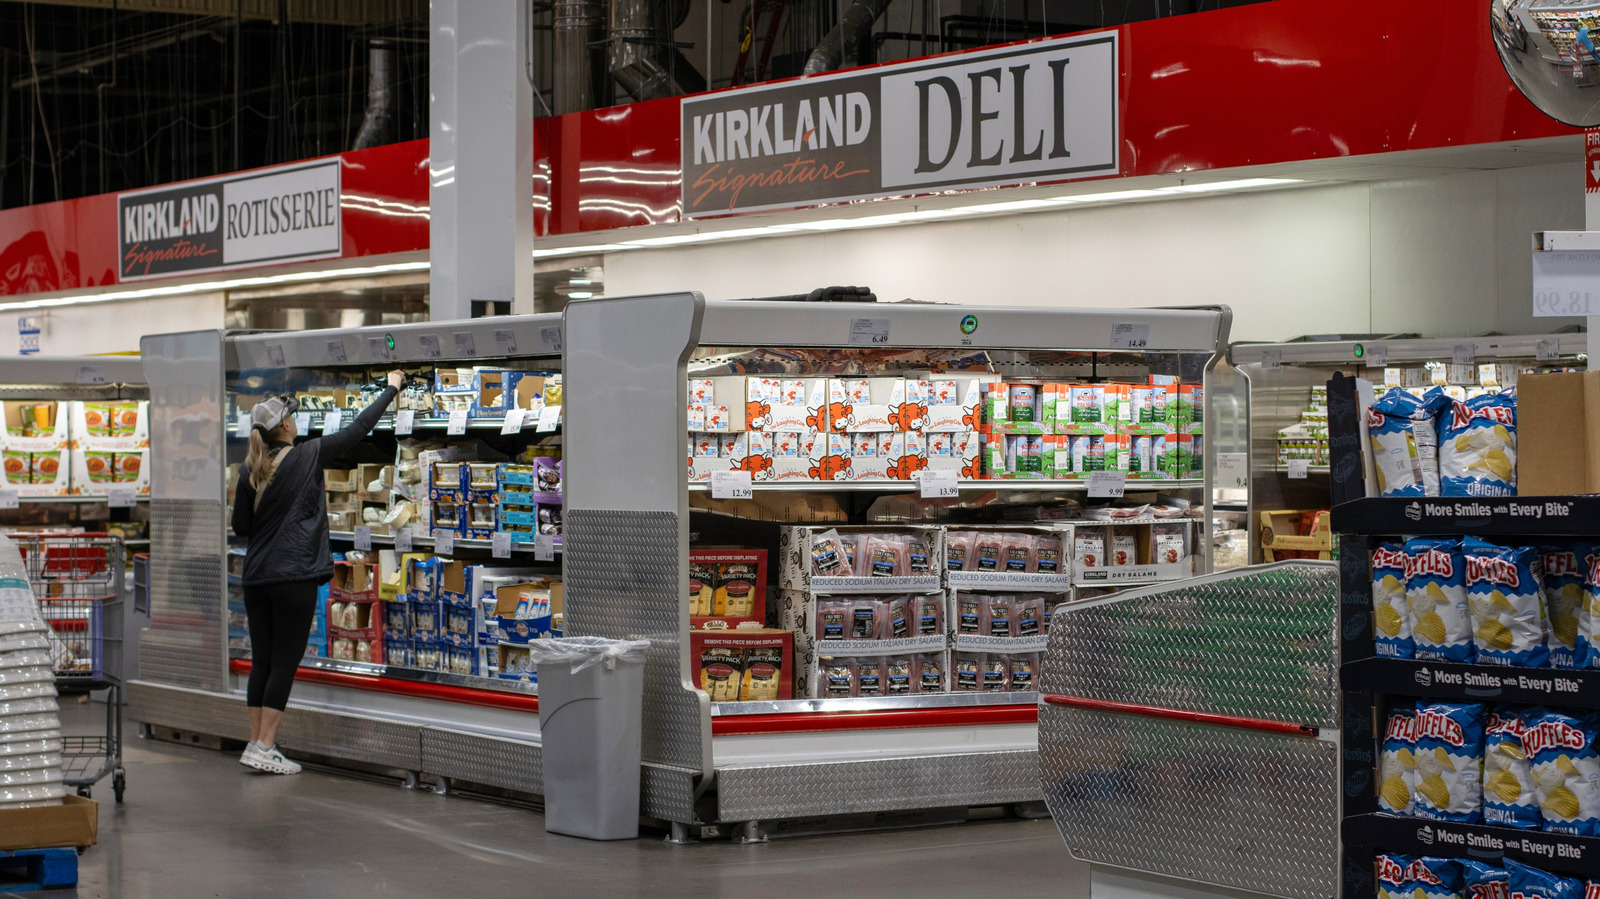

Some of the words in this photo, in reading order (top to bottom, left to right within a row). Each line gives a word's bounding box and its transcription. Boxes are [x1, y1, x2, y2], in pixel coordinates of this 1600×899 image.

[914, 58, 1071, 175] DELI
[693, 91, 872, 166] KIRKLAND
[692, 157, 870, 211] Signature
[124, 193, 219, 244] KIRKLAND
[225, 187, 336, 240] ROTISSERIE
[124, 241, 218, 276] Signature
[872, 335, 888, 343] 6.49
[1127, 339, 1146, 347] 14.49
[732, 489, 752, 497] 12.99
[939, 488, 958, 496] 13.99
[1424, 503, 1453, 516] More
[1454, 503, 1491, 516] Smiles
[1493, 505, 1508, 514] with
[1509, 503, 1542, 519] Every
[811, 578, 843, 586] REDUCED
[845, 578, 872, 586] SODIUM
[873, 577, 897, 585] ITALIAN
[899, 577, 911, 585] DRY
[912, 577, 937, 585] SALAME
[950, 573, 979, 581] REDUCED
[981, 574, 1006, 582] SODIUM
[1031, 575, 1043, 583] DRY
[1044, 576, 1068, 584] SALAME
[1467, 556, 1520, 587] UFFLES
[853, 641, 880, 649] SODIUM
[881, 640, 904, 648] ITALIAN
[918, 637, 943, 645] SALAME
[958, 636, 987, 644] REDUCED
[989, 637, 1014, 646] SODIUM
[1014, 637, 1036, 645] ITALIAN
[1434, 670, 1462, 684] More
[1464, 672, 1501, 687] Smiles
[1502, 678, 1518, 686] with
[1518, 676, 1551, 693] Every
[1521, 721, 1585, 759] RUFFLES
[1437, 829, 1465, 844] More
[1467, 833, 1503, 849] Smiles
[1505, 841, 1520, 849] with
[1521, 839, 1554, 857] Every
